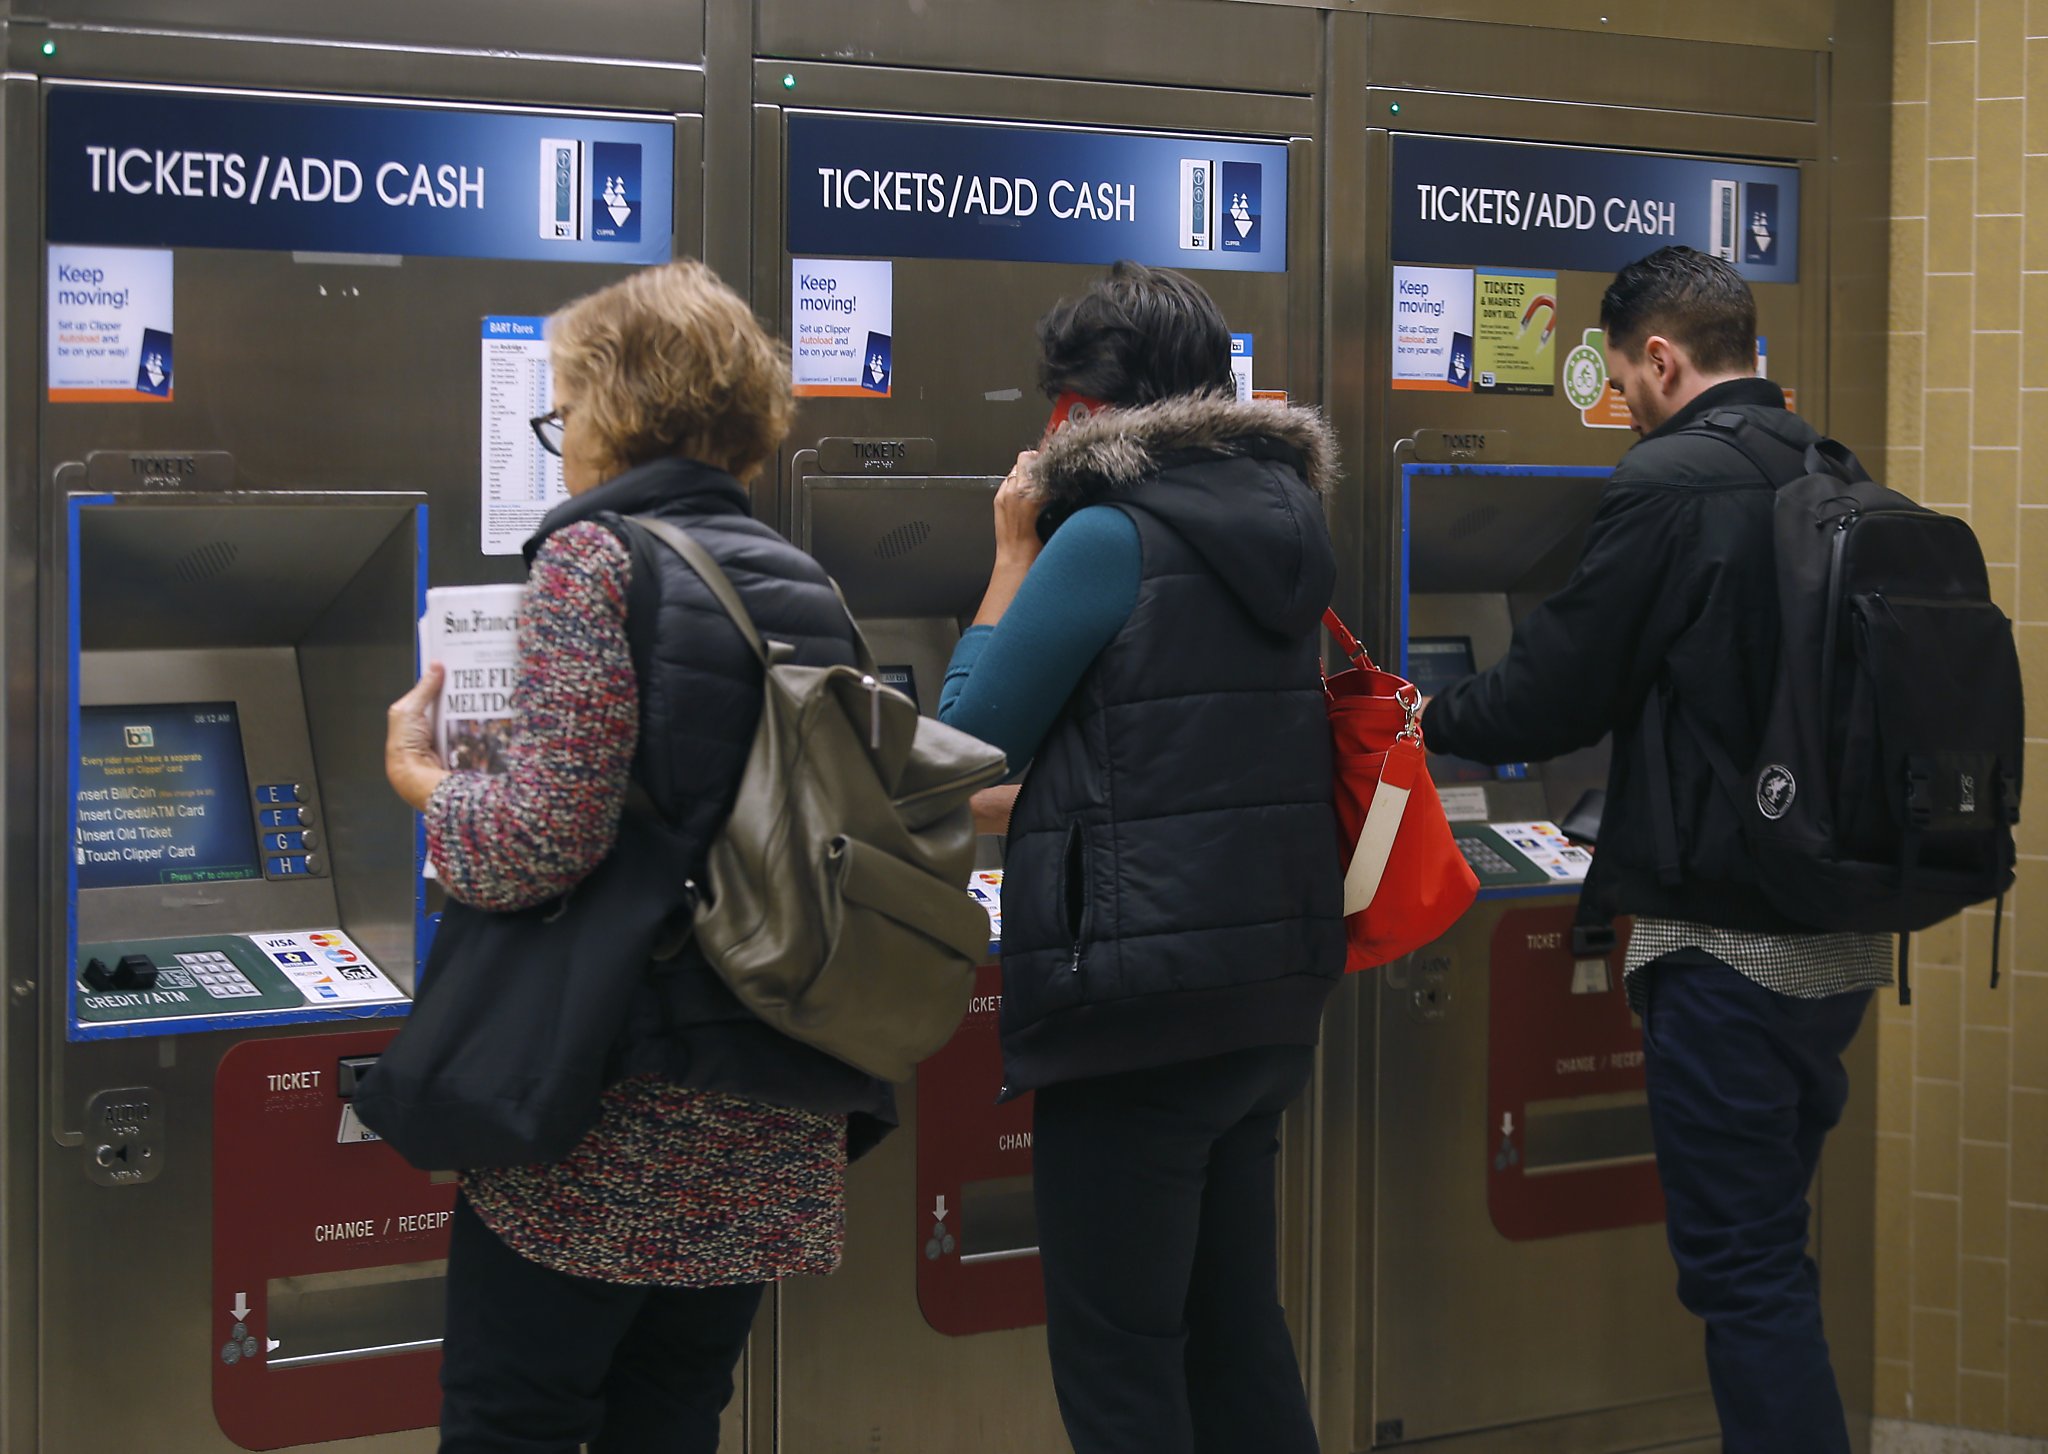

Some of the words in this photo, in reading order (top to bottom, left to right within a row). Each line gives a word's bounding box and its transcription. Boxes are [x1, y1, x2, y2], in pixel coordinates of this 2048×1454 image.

[86, 145, 363, 205] TICKETS/ADD
[375, 161, 485, 209] CASH
[818, 167, 1038, 218] TICKETS/ADD
[1048, 179, 1136, 222] CASH
[1417, 184, 1597, 230] TICKETS/ADD
[1603, 197, 1676, 236] CASH
[58, 265, 104, 286] Keep
[800, 274, 837, 294] Keep
[1399, 280, 1429, 298] Keep
[1484, 280, 1526, 296] TICKETS
[58, 288, 129, 310] moving!
[800, 295, 857, 315] moving!
[1399, 298, 1445, 317] moving!
[1481, 297, 1486, 306] &
[1488, 297, 1521, 307] MAGNETS
[58, 321, 73, 331] Set
[75, 322, 87, 333] up
[89, 321, 121, 333] Clipper
[490, 322, 511, 333] BART
[512, 323, 534, 334] Fares
[800, 323, 812, 334] Set
[813, 324, 823, 336] up
[824, 324, 851, 336] Clipper
[1399, 325, 1408, 334] Set
[1409, 327, 1418, 335] up
[1419, 326, 1440, 335] Clipper
[58, 334, 100, 344] Autoload
[102, 335, 119, 344] and
[800, 336, 833, 346] Autoload
[834, 336, 849, 345] and
[1399, 336, 1425, 344] Autoload
[1426, 336, 1438, 344] and
[58, 348, 69, 357] be
[86, 349, 106, 360] your
[108, 347, 129, 360] way!
[800, 346, 809, 356] be
[810, 348, 820, 356] on
[822, 348, 838, 358] your
[839, 347, 857, 358] way!
[1416, 347, 1429, 356] your
[1431, 347, 1444, 357] way!
[853, 441, 905, 458] TICKETS
[1442, 434, 1485, 449] TICKETS
[130, 456, 195, 474] TICKETS
[445, 611, 468, 633] San
[470, 609, 520, 632] Franci
[453, 668, 483, 688] THE
[82, 756, 104, 766] Every
[105, 755, 122, 764] rider
[124, 755, 143, 763] must
[144, 754, 162, 762] have
[170, 753, 203, 763] separate
[104, 766, 126, 775] ticket
[1507, 763, 1517, 777] H
[111, 787, 157, 800] Bill/Coin
[269, 786, 280, 803] E
[79, 808, 112, 821] Insert
[114, 806, 175, 820] Credit/ATM
[178, 804, 205, 817] Card
[273, 810, 282, 826] F
[83, 829, 115, 842] Insert
[117, 827, 137, 840] Old
[138, 826, 173, 839] Ticket
[277, 833, 288, 850] G
[86, 849, 121, 862] Touch
[168, 844, 196, 858] Card
[280, 857, 292, 873] H
[171, 872, 192, 881] Press
[216, 870, 243, 880] change
[265, 938, 297, 948] VISA
[1525, 932, 1562, 949] TICKET
[344, 967, 376, 980] STAR
[84, 994, 144, 1009] CREDIT
[154, 990, 190, 1003] ATM
[968, 995, 1003, 1013] ICKET
[1556, 1056, 1595, 1074] CHANGE
[1610, 1051, 1645, 1068] RECEIP
[267, 1070, 321, 1092] TICKET
[999, 1132, 1034, 1151] CHAN
[315, 1219, 375, 1242] CHANGE
